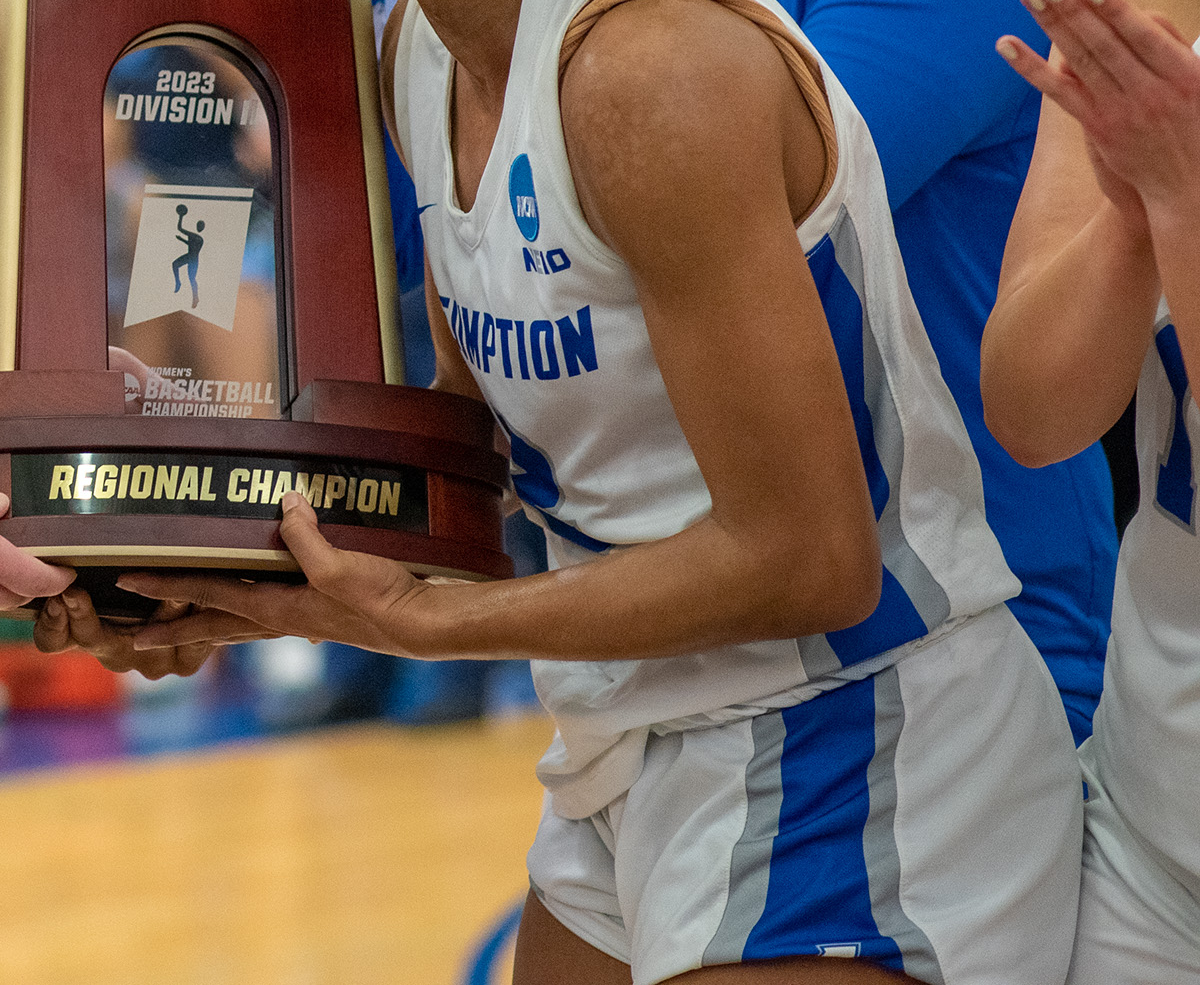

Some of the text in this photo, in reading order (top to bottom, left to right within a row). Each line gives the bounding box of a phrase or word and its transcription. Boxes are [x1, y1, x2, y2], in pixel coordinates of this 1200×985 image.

[155, 69, 216, 94] 2023
[115, 94, 234, 125] DIVISION
[143, 378, 275, 405] BASKETBALL
[141, 400, 253, 419] CHAMPIONSHIP
[48, 464, 401, 516] REGIONAL CHAMPION
